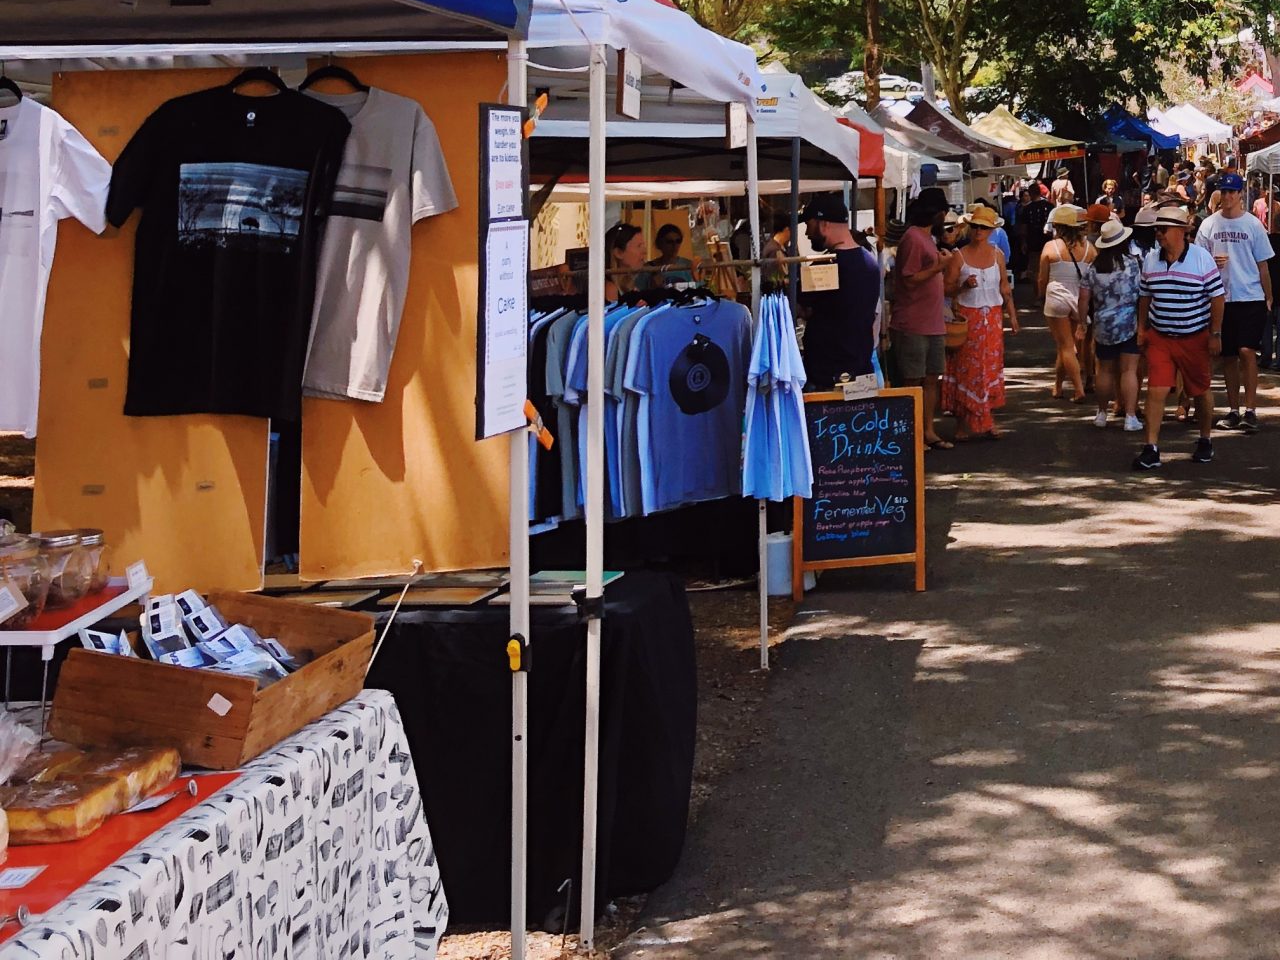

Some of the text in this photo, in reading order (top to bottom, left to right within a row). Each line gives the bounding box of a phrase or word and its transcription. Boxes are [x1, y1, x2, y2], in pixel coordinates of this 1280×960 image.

[1214, 231, 1248, 240] QUEENSLAND
[814, 408, 890, 438] Ice Cold
[830, 431, 901, 463] Drinks
[875, 495, 906, 522] Veg
